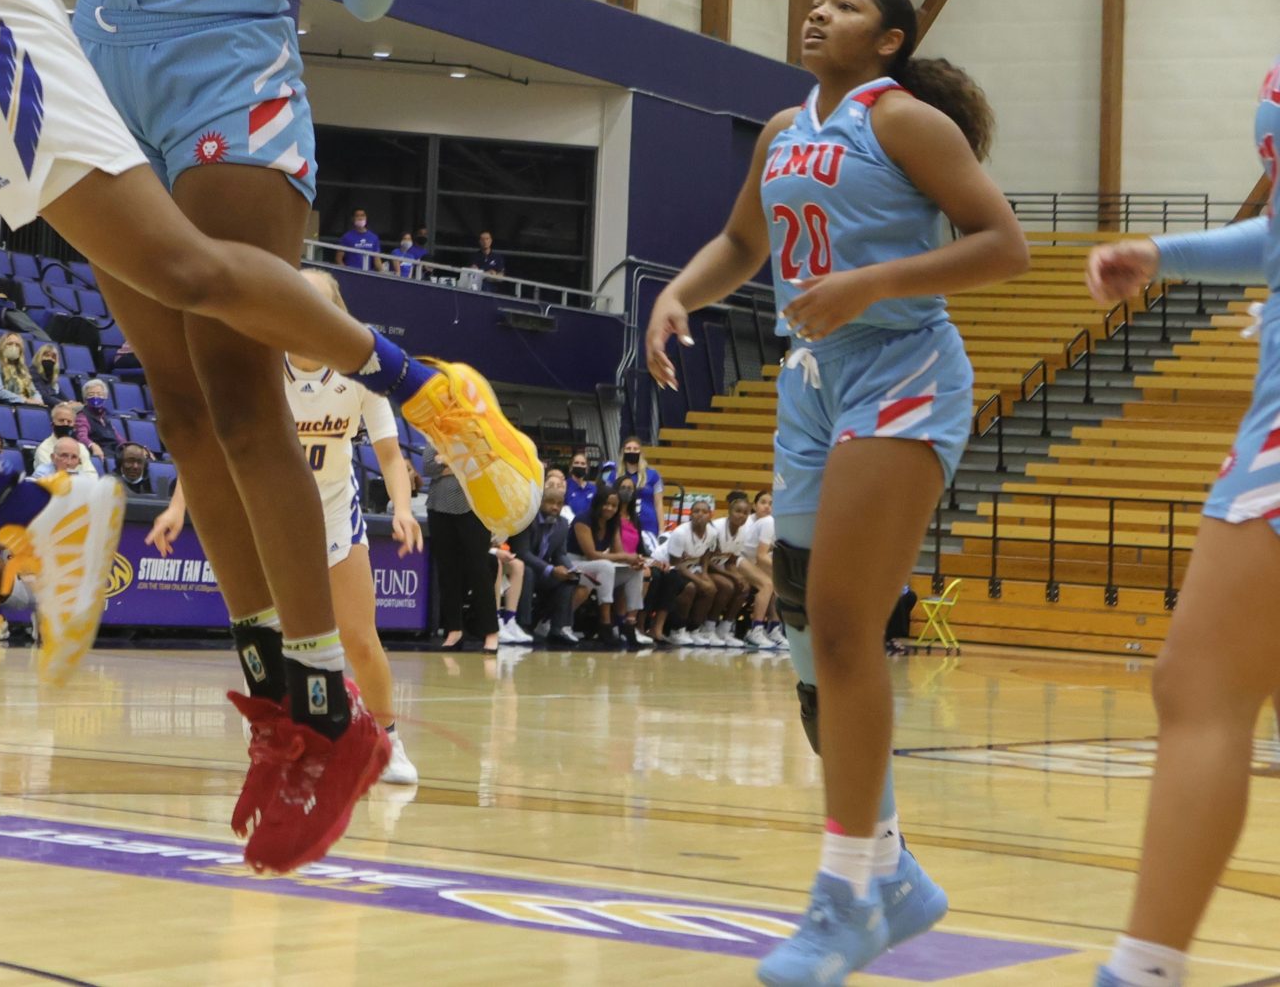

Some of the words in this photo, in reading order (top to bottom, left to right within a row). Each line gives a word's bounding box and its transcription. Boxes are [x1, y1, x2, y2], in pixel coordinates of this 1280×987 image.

[761, 142, 848, 188] LMU
[771, 201, 833, 282] 20
[138, 558, 182, 582] STUDENT
[181, 560, 202, 583] FAN
[373, 569, 418, 596] FUND
[376, 598, 417, 609] PPORTUNITIES
